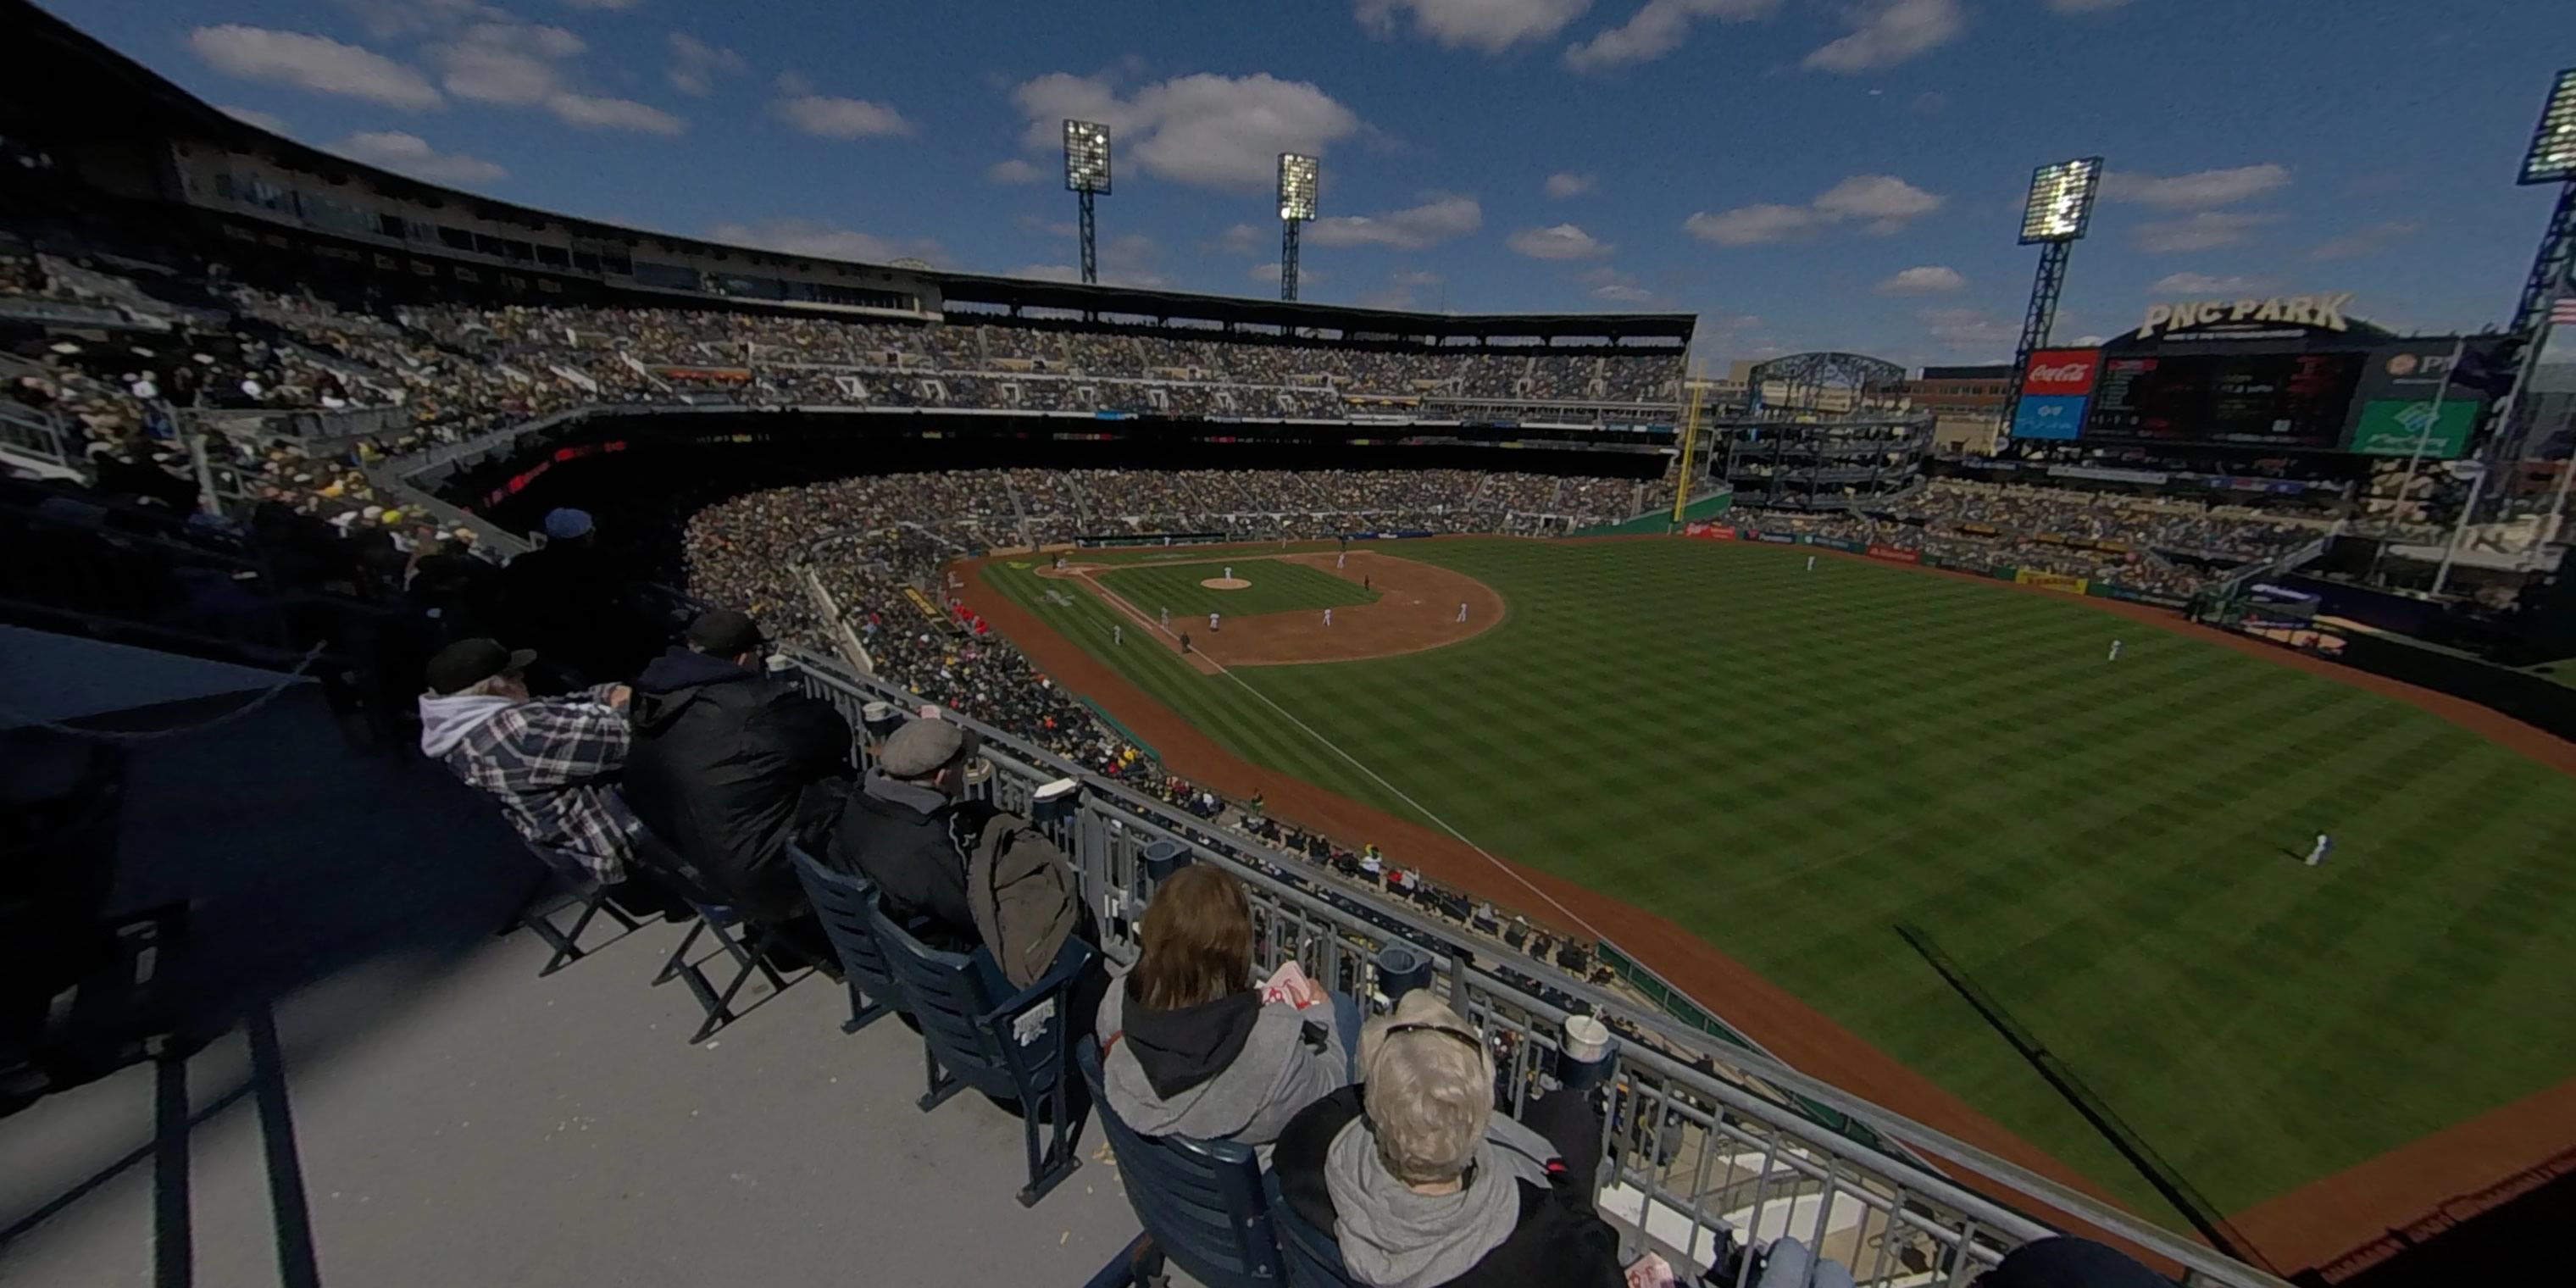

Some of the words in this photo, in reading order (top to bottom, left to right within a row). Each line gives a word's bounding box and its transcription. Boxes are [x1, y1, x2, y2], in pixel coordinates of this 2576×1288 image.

[2137, 301, 2223, 340] PNC
[2230, 293, 2351, 332] PARK
[2029, 363, 2090, 383] Coca-Cola
